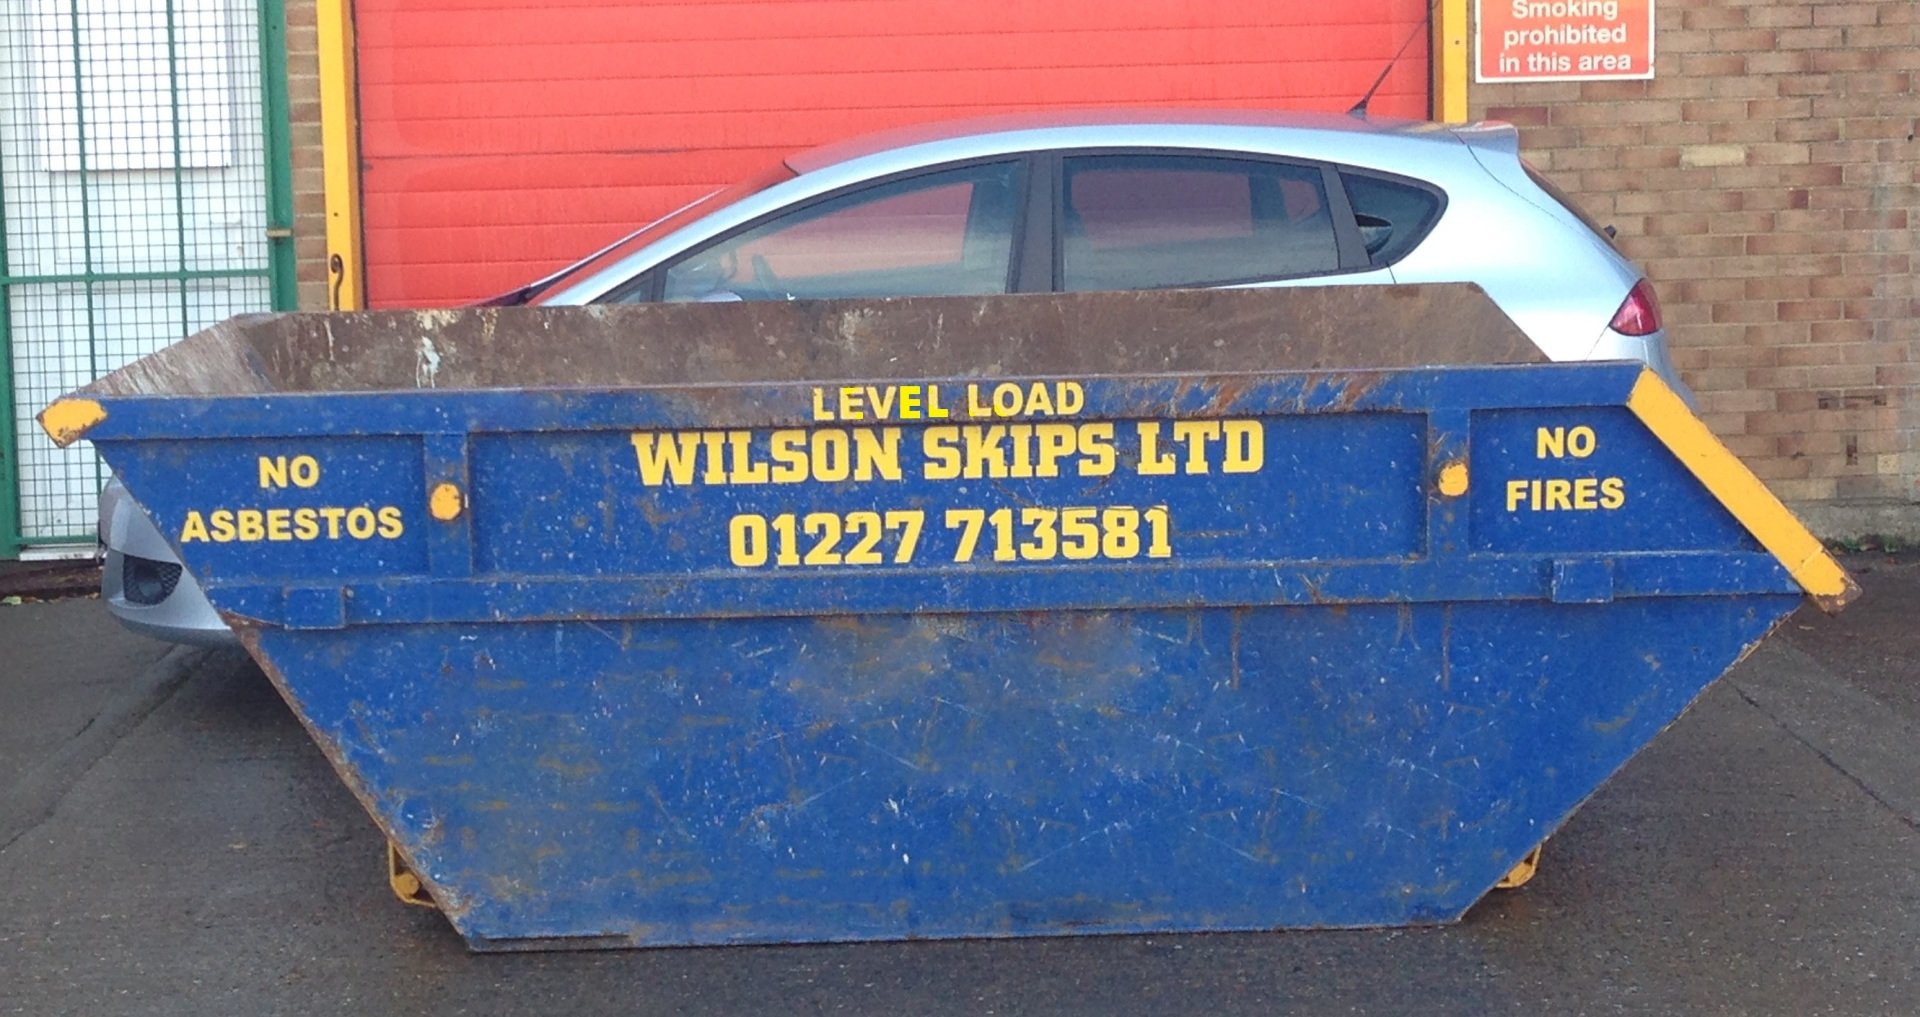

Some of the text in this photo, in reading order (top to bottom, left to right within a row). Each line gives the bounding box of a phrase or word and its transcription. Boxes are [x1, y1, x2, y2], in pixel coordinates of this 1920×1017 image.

[1512, 0, 1617, 20] Smoking
[1504, 24, 1626, 49] prohibited
[1500, 52, 1631, 72] in this area
[813, 382, 1084, 421] LEVEL LOAD
[632, 420, 1264, 486] WILSON SKIPS LTD
[1536, 426, 1596, 459] NO
[258, 455, 320, 489] NO
[1506, 477, 1625, 511] FIRES
[180, 506, 404, 543] ASBESTOS
[729, 505, 1172, 567] 01227 713581
